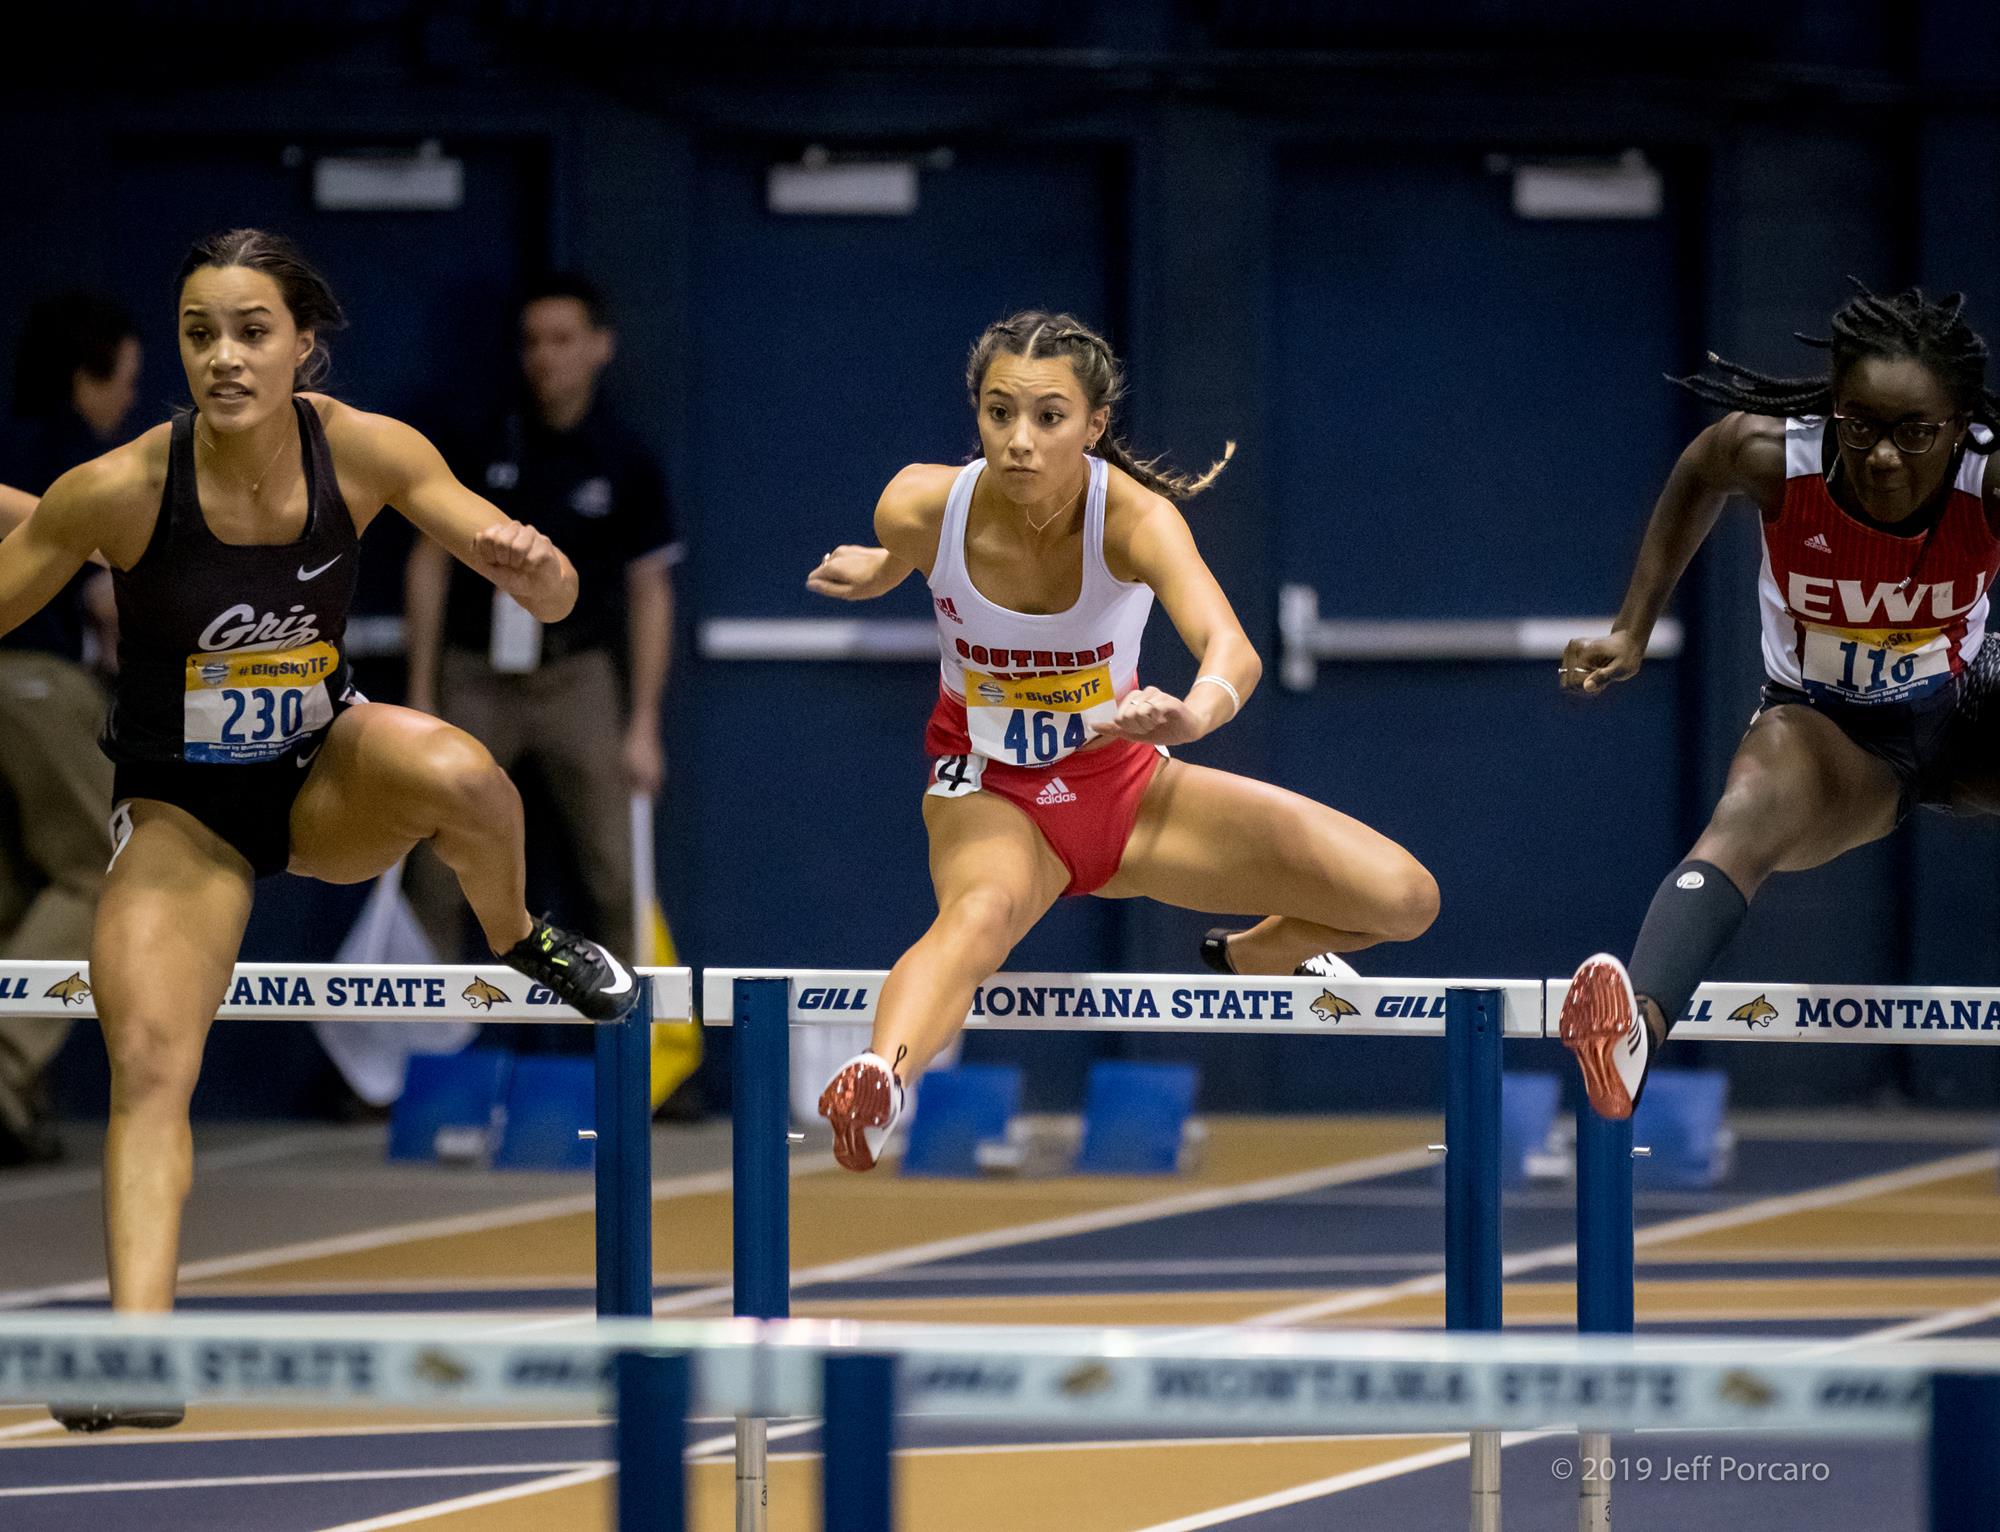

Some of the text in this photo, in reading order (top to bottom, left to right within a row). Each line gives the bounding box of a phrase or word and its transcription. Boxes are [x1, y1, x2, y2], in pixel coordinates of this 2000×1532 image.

[1787, 570, 1987, 623] EWU
[198, 603, 320, 650] Griz
[239, 656, 329, 677] #BigSkyTF
[955, 637, 1115, 668] SOUTHERN
[1014, 678, 1101, 705] #BigSkyTF
[221, 687, 305, 744] 230
[1003, 708, 1088, 764] 464
[937, 754, 972, 792] 4
[1035, 791, 1077, 804] adidas
[326, 977, 446, 1008] STATE
[797, 988, 868, 1010] GILL
[1171, 988, 1293, 1020] STATE
[1374, 995, 1446, 1019] GILL
[1795, 997, 2000, 1031] MONTANA
